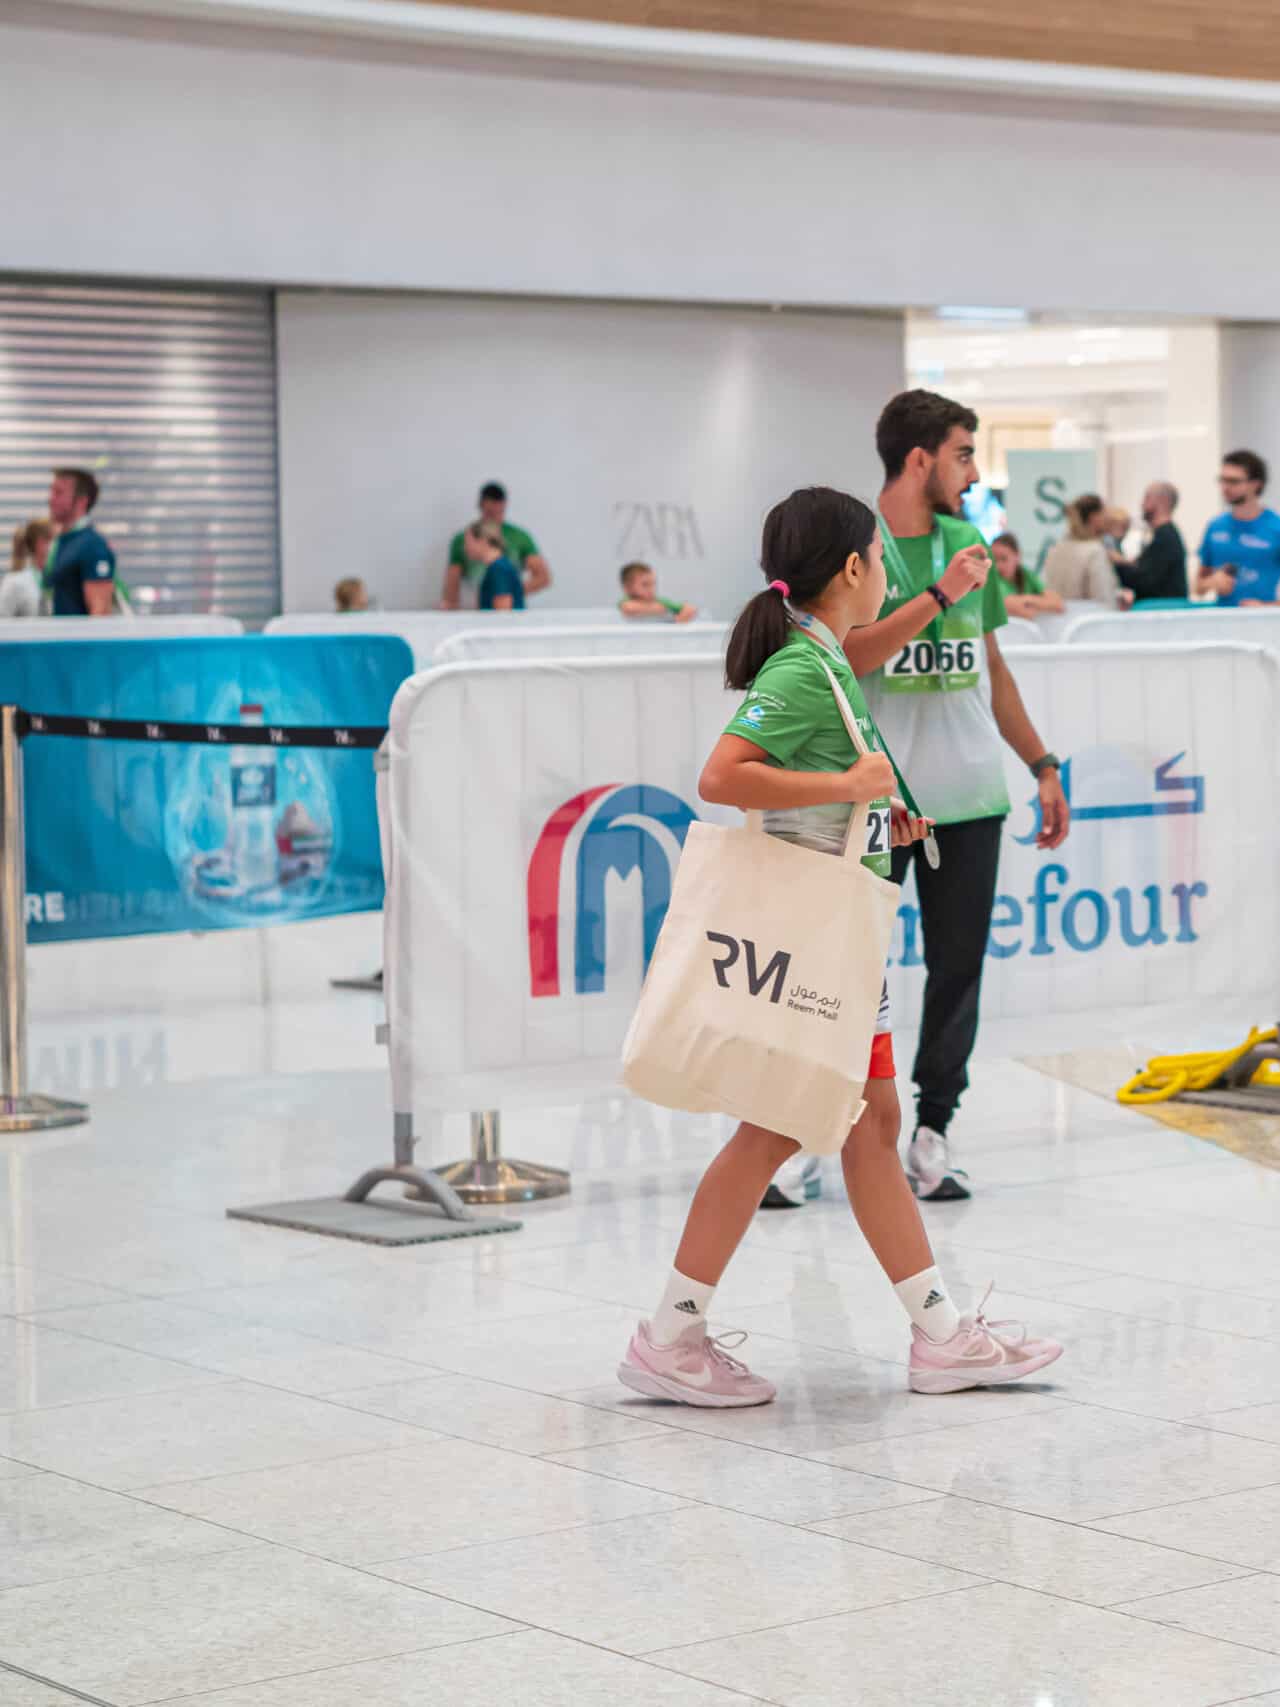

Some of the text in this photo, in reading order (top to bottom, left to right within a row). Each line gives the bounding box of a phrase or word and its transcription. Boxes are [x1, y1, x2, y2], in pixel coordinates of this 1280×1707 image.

[893, 641, 975, 675] 2066
[706, 930, 792, 1004] RM
[787, 1000, 838, 1021] Reem Mall
